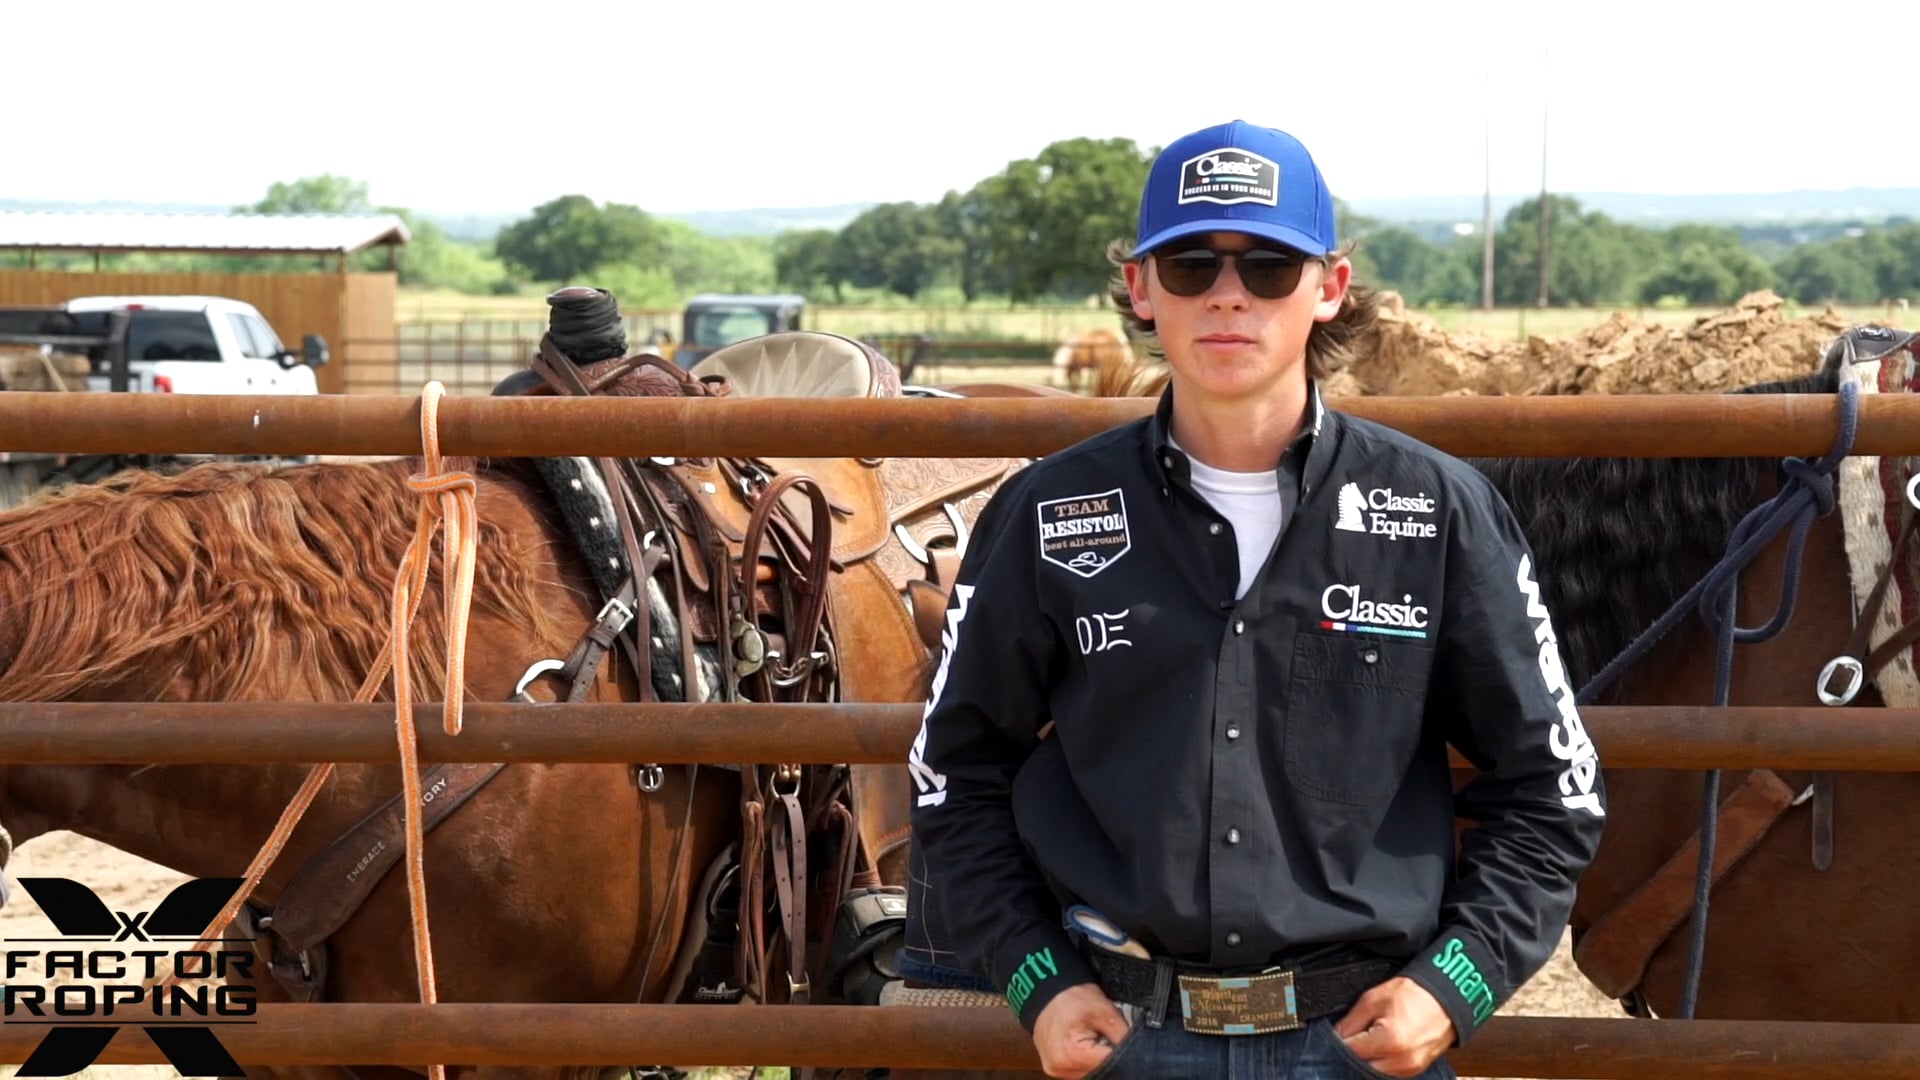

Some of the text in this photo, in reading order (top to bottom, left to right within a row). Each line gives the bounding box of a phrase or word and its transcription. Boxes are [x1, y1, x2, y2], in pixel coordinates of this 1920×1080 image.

[1054, 499, 1110, 518] TEAM
[1368, 488, 1436, 513] Classic
[1042, 513, 1124, 539] RESISTOL
[1369, 513, 1438, 540] Equine
[1044, 533, 1126, 552] best all-around
[1321, 584, 1429, 628] Classic
[1006, 946, 1058, 1022] marty
